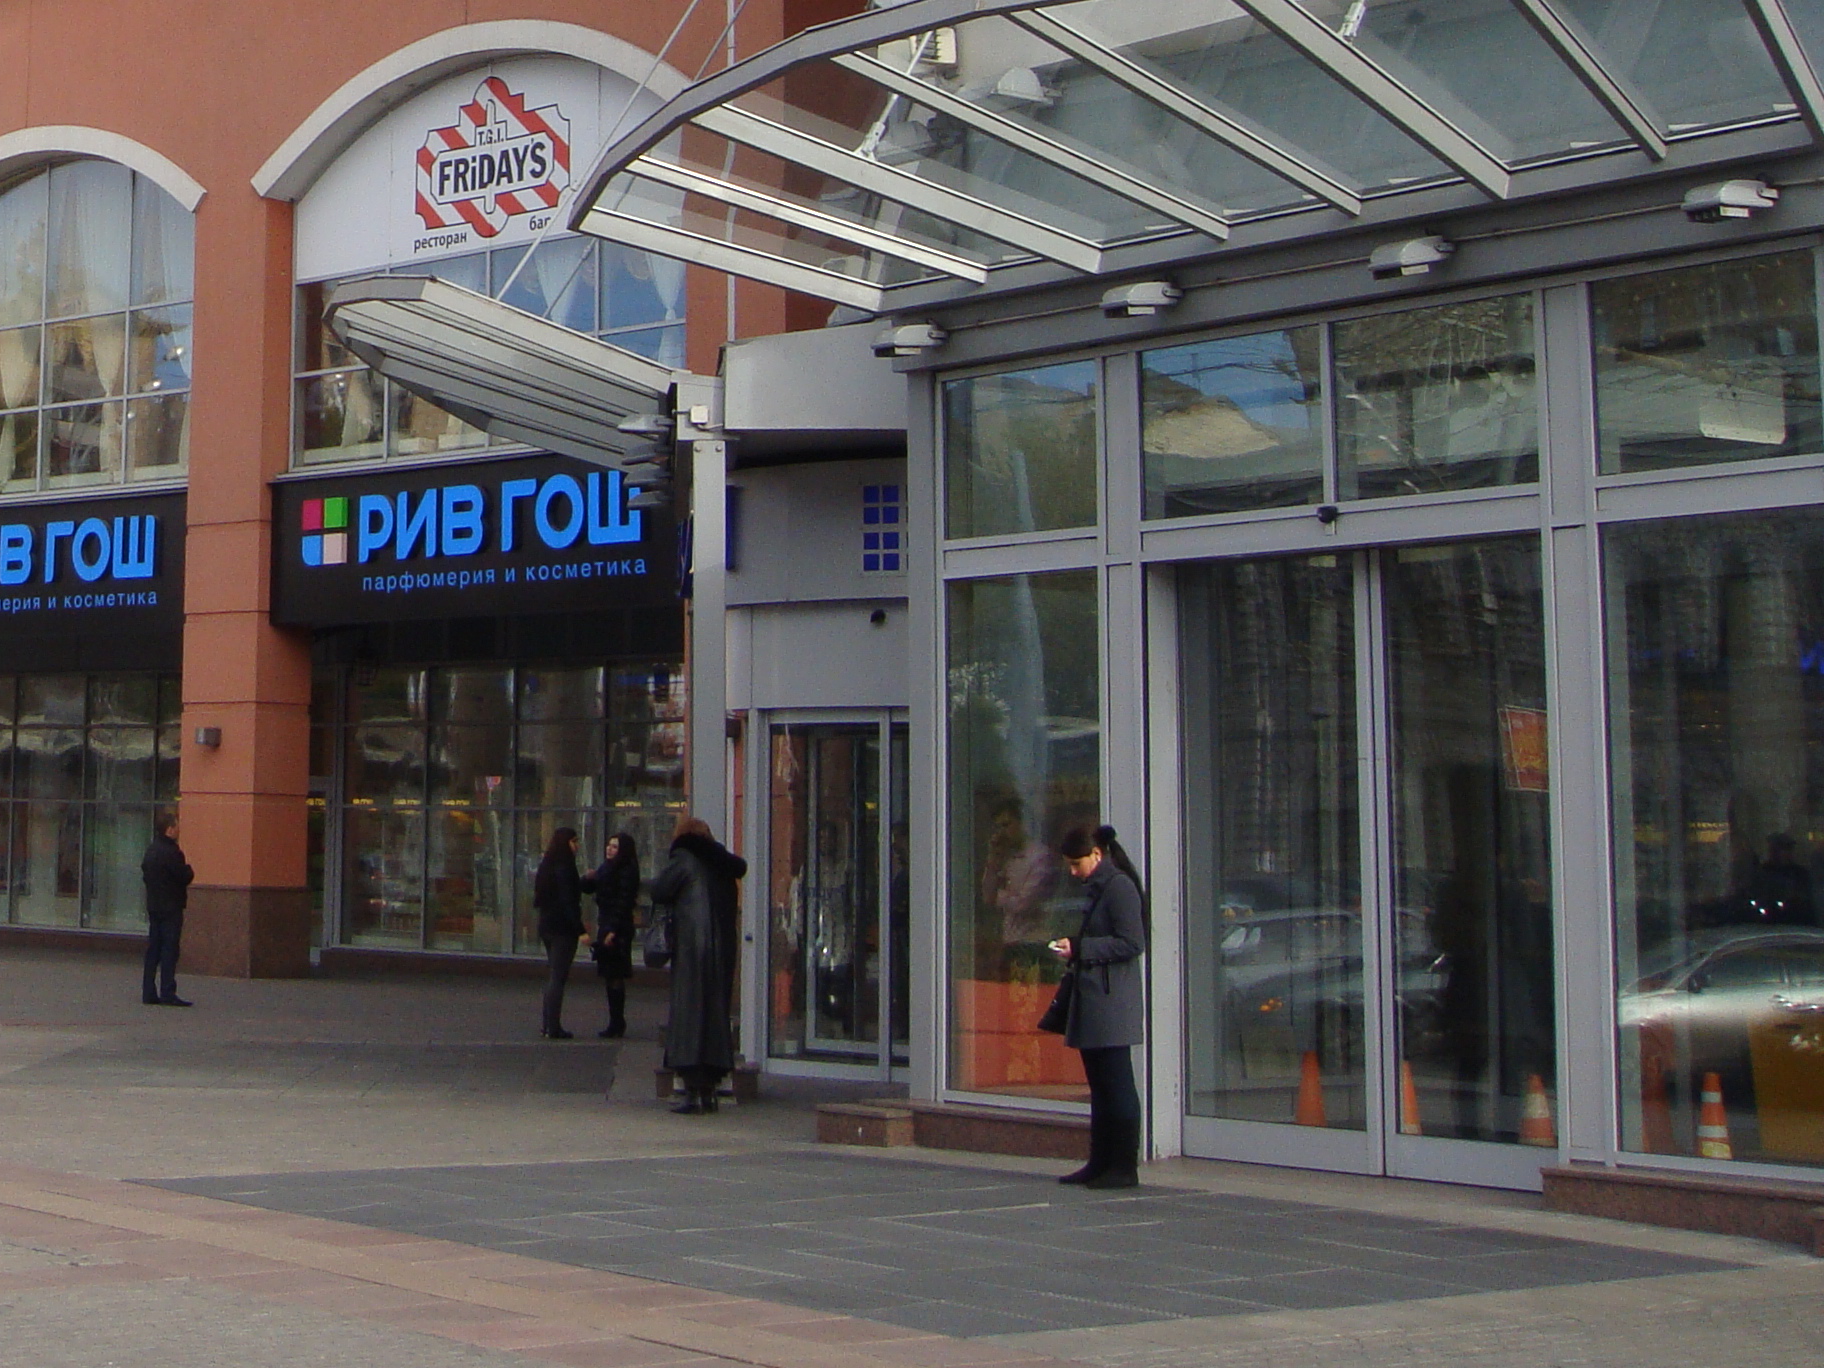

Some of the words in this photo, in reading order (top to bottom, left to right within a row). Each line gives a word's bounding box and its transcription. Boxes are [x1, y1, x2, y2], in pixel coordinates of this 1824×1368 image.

[478, 128, 505, 146] T.G.I.
[414, 232, 467, 253] ресторан
[358, 484, 484, 564] РИВ
[501, 470, 642, 552] ГОШ
[44, 514, 156, 584] ГОШ
[362, 568, 496, 593] парфюмерия
[505, 567, 516, 582] и
[526, 558, 647, 581] косметика
[48, 597, 57, 609] и
[64, 590, 158, 608] косметика
